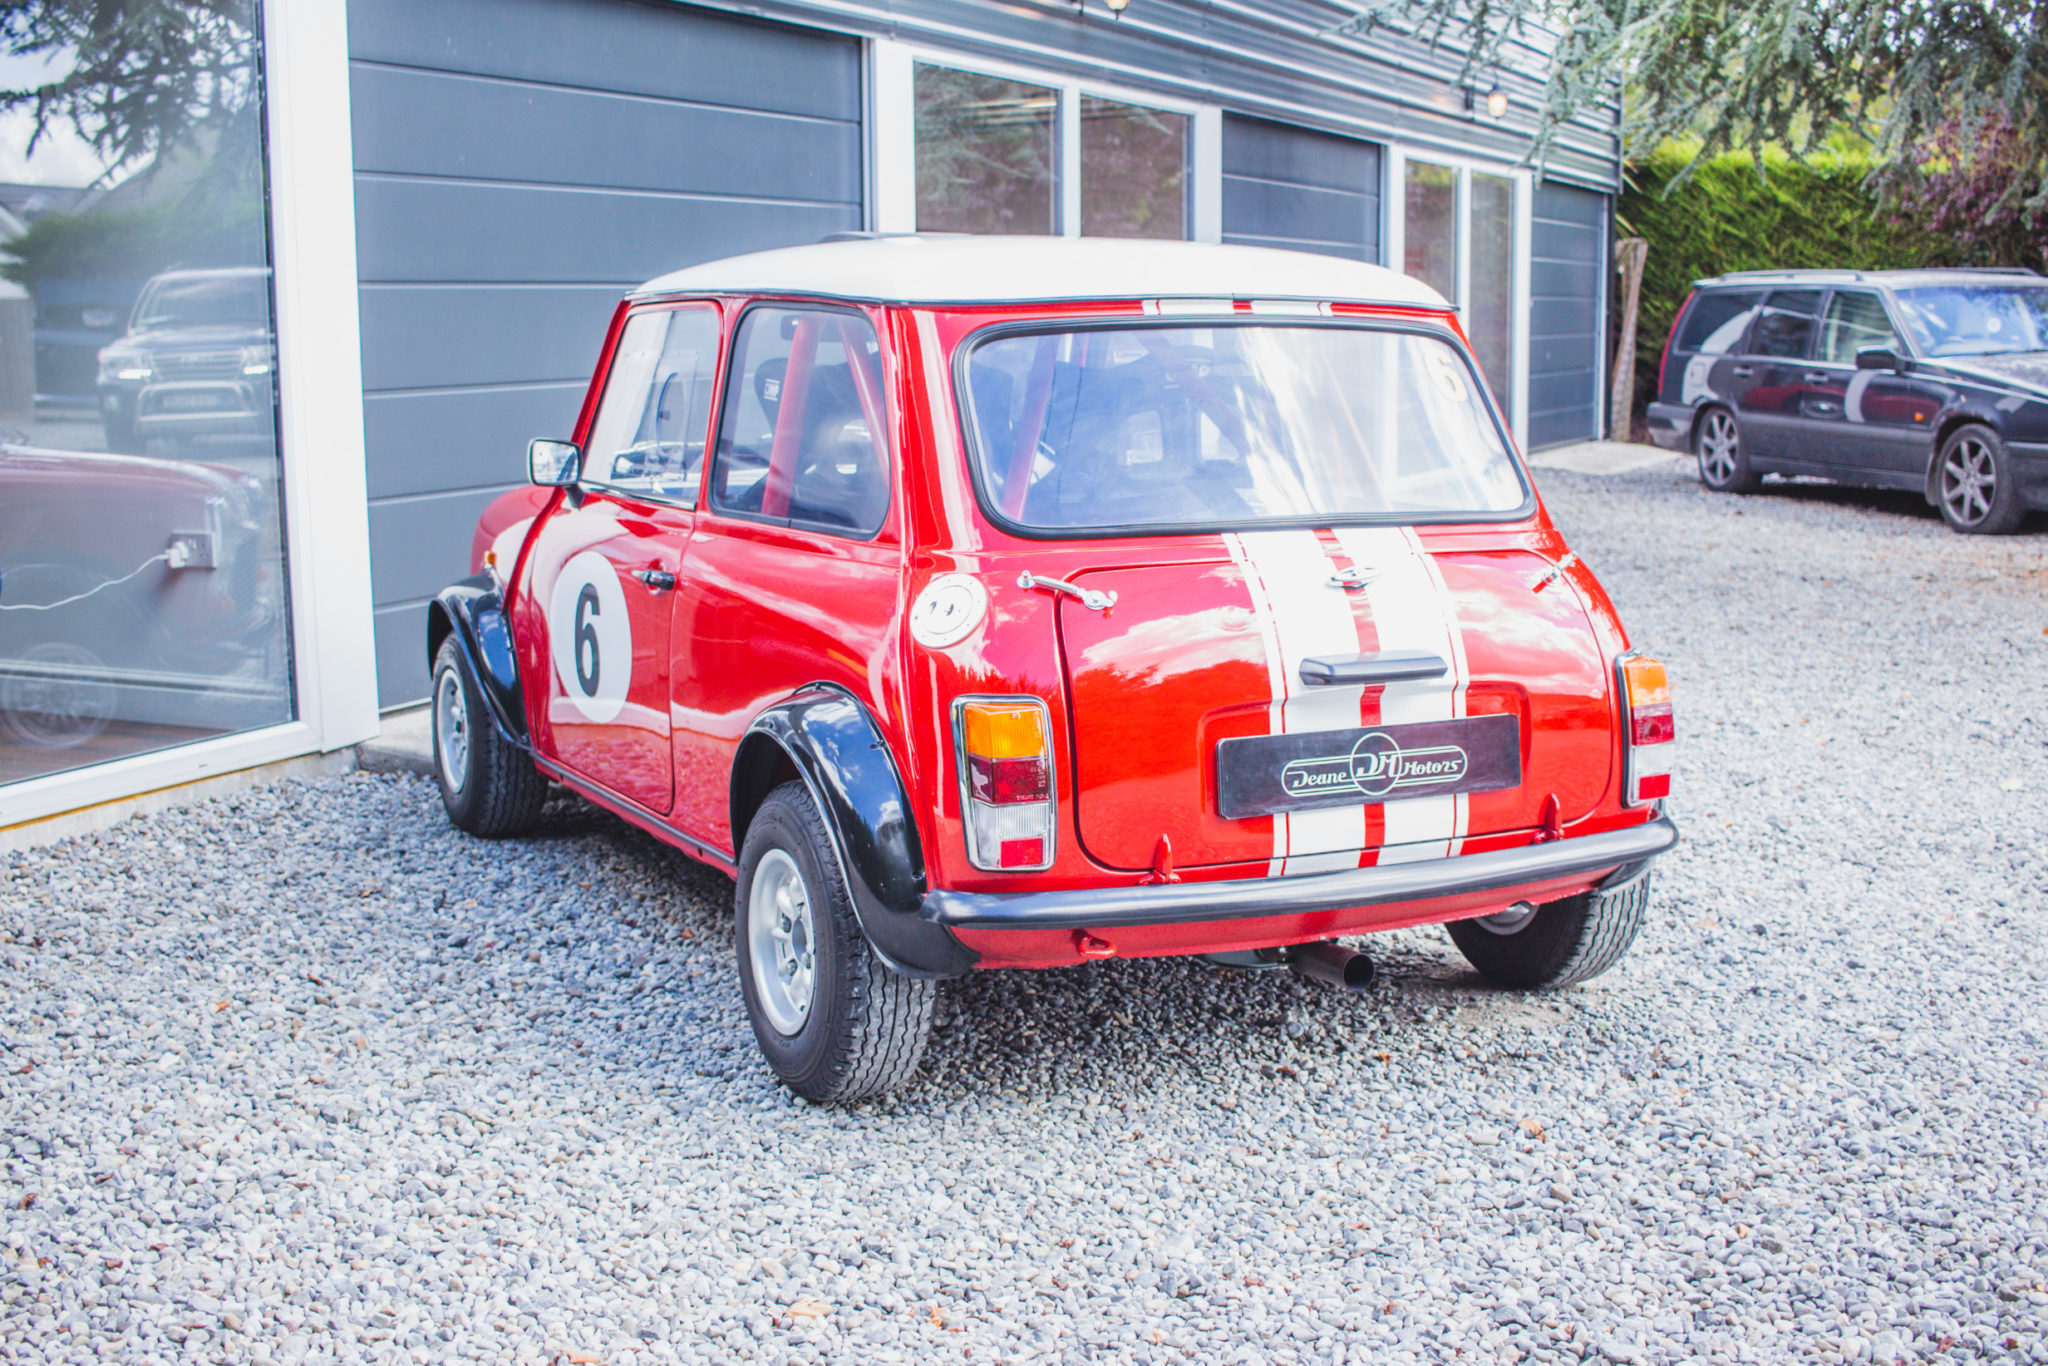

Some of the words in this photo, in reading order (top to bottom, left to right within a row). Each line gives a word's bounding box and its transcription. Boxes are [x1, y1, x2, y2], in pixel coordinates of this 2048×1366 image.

[1423, 347, 1467, 402] 6
[575, 583, 600, 697] 6
[1287, 771, 1347, 788] Deane
[1403, 760, 1462, 776] Motors
